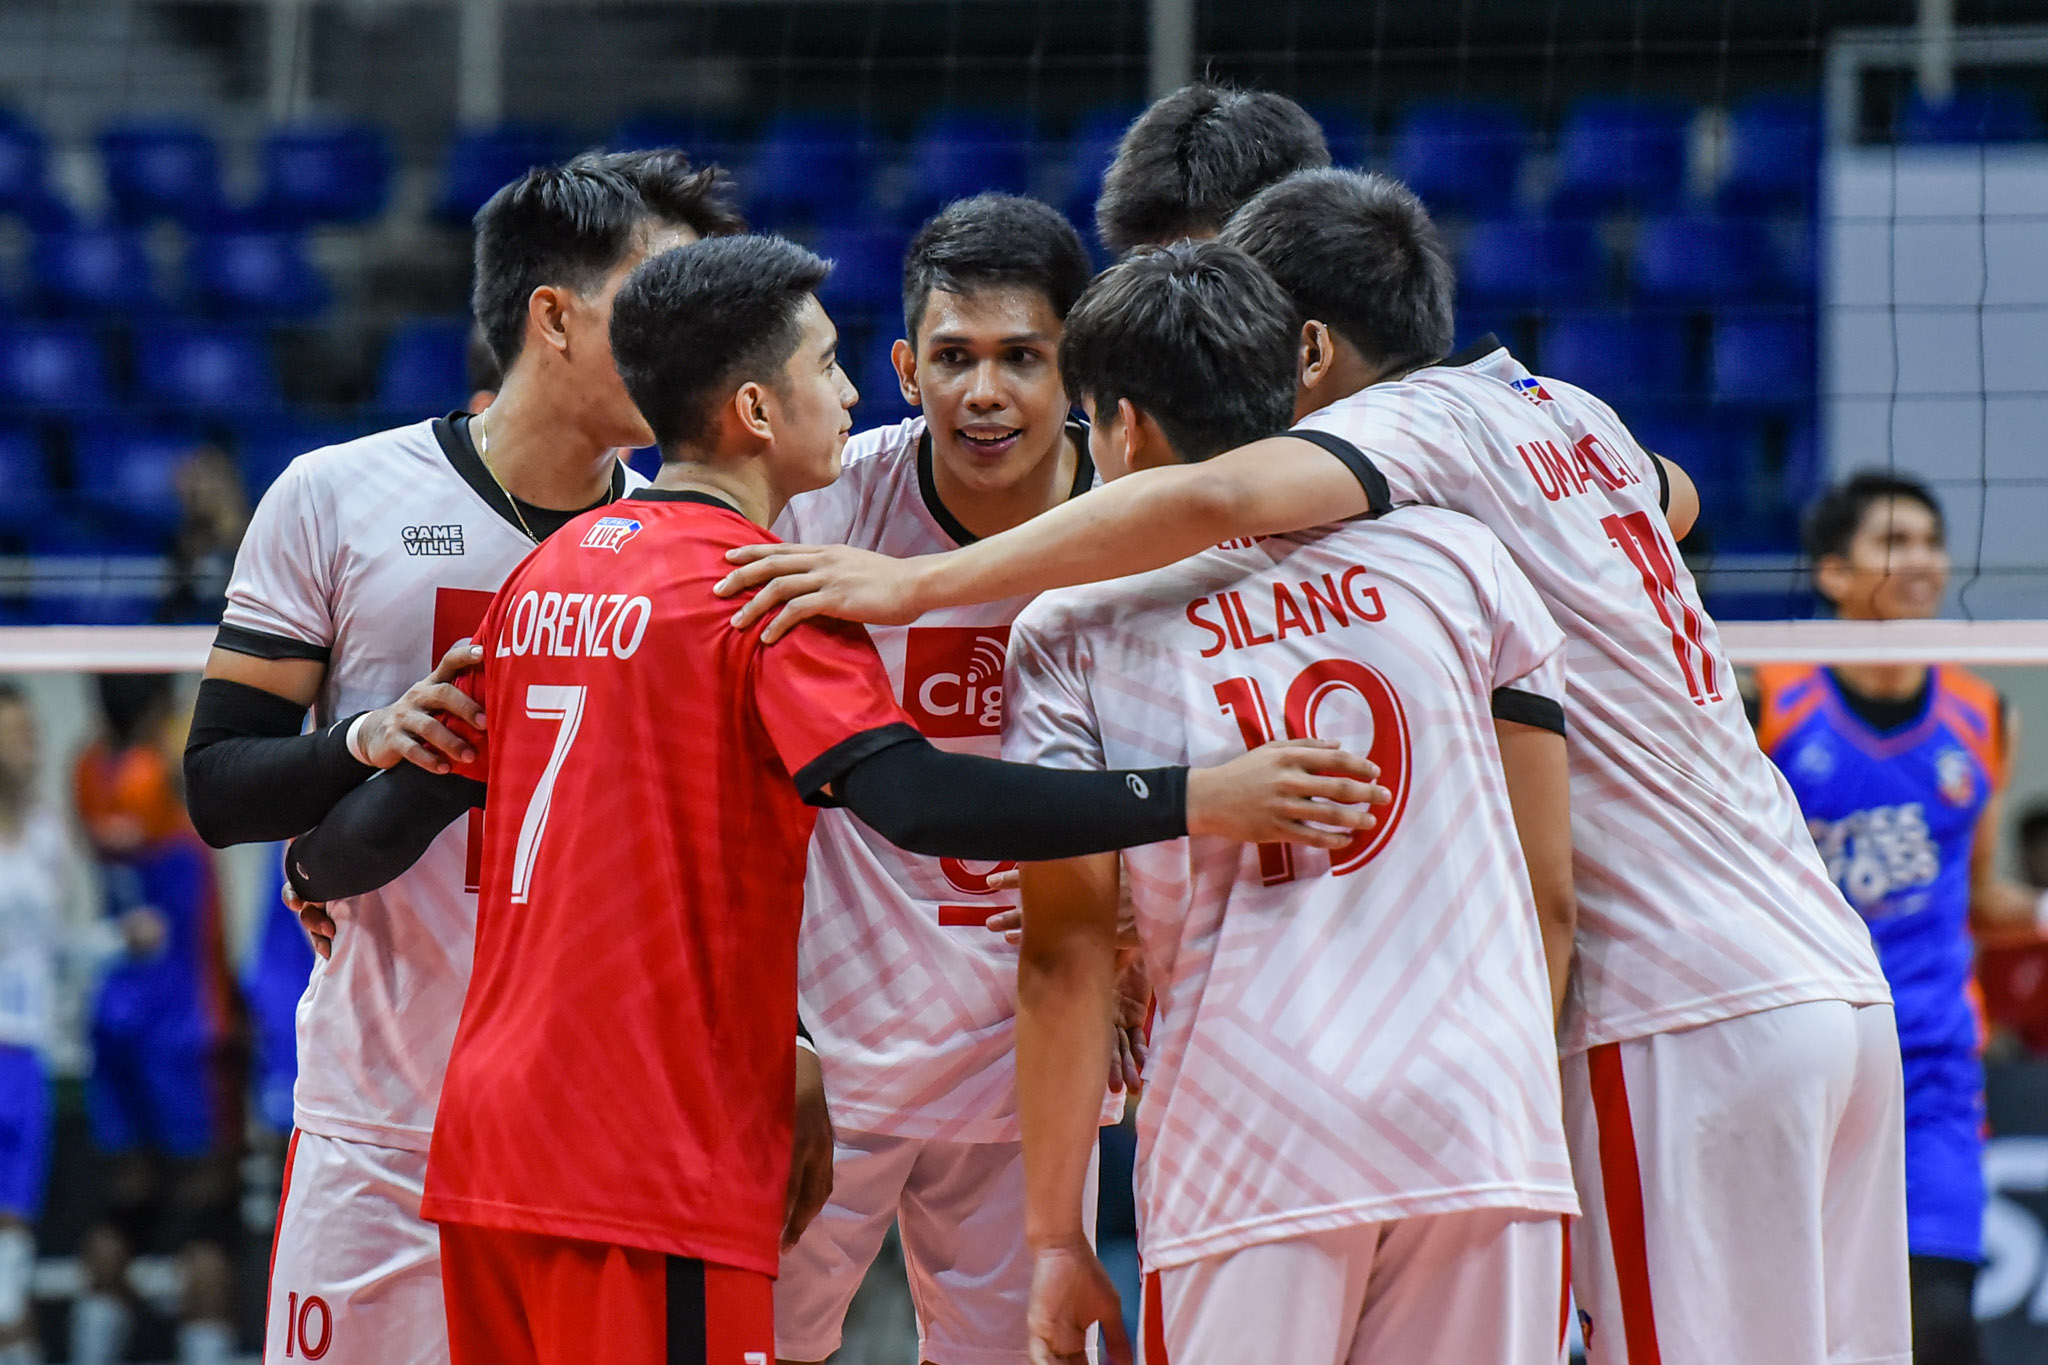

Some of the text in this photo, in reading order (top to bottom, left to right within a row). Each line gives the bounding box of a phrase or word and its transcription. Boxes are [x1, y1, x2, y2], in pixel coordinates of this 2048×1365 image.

[401, 525, 463, 541] GAME
[403, 540, 465, 556] VILLE
[582, 527, 624, 546] LIVE
[496, 590, 651, 660] LORENZO
[1186, 565, 1387, 658] SILANG
[510, 684, 588, 904] 7
[286, 1291, 333, 1361] 10
